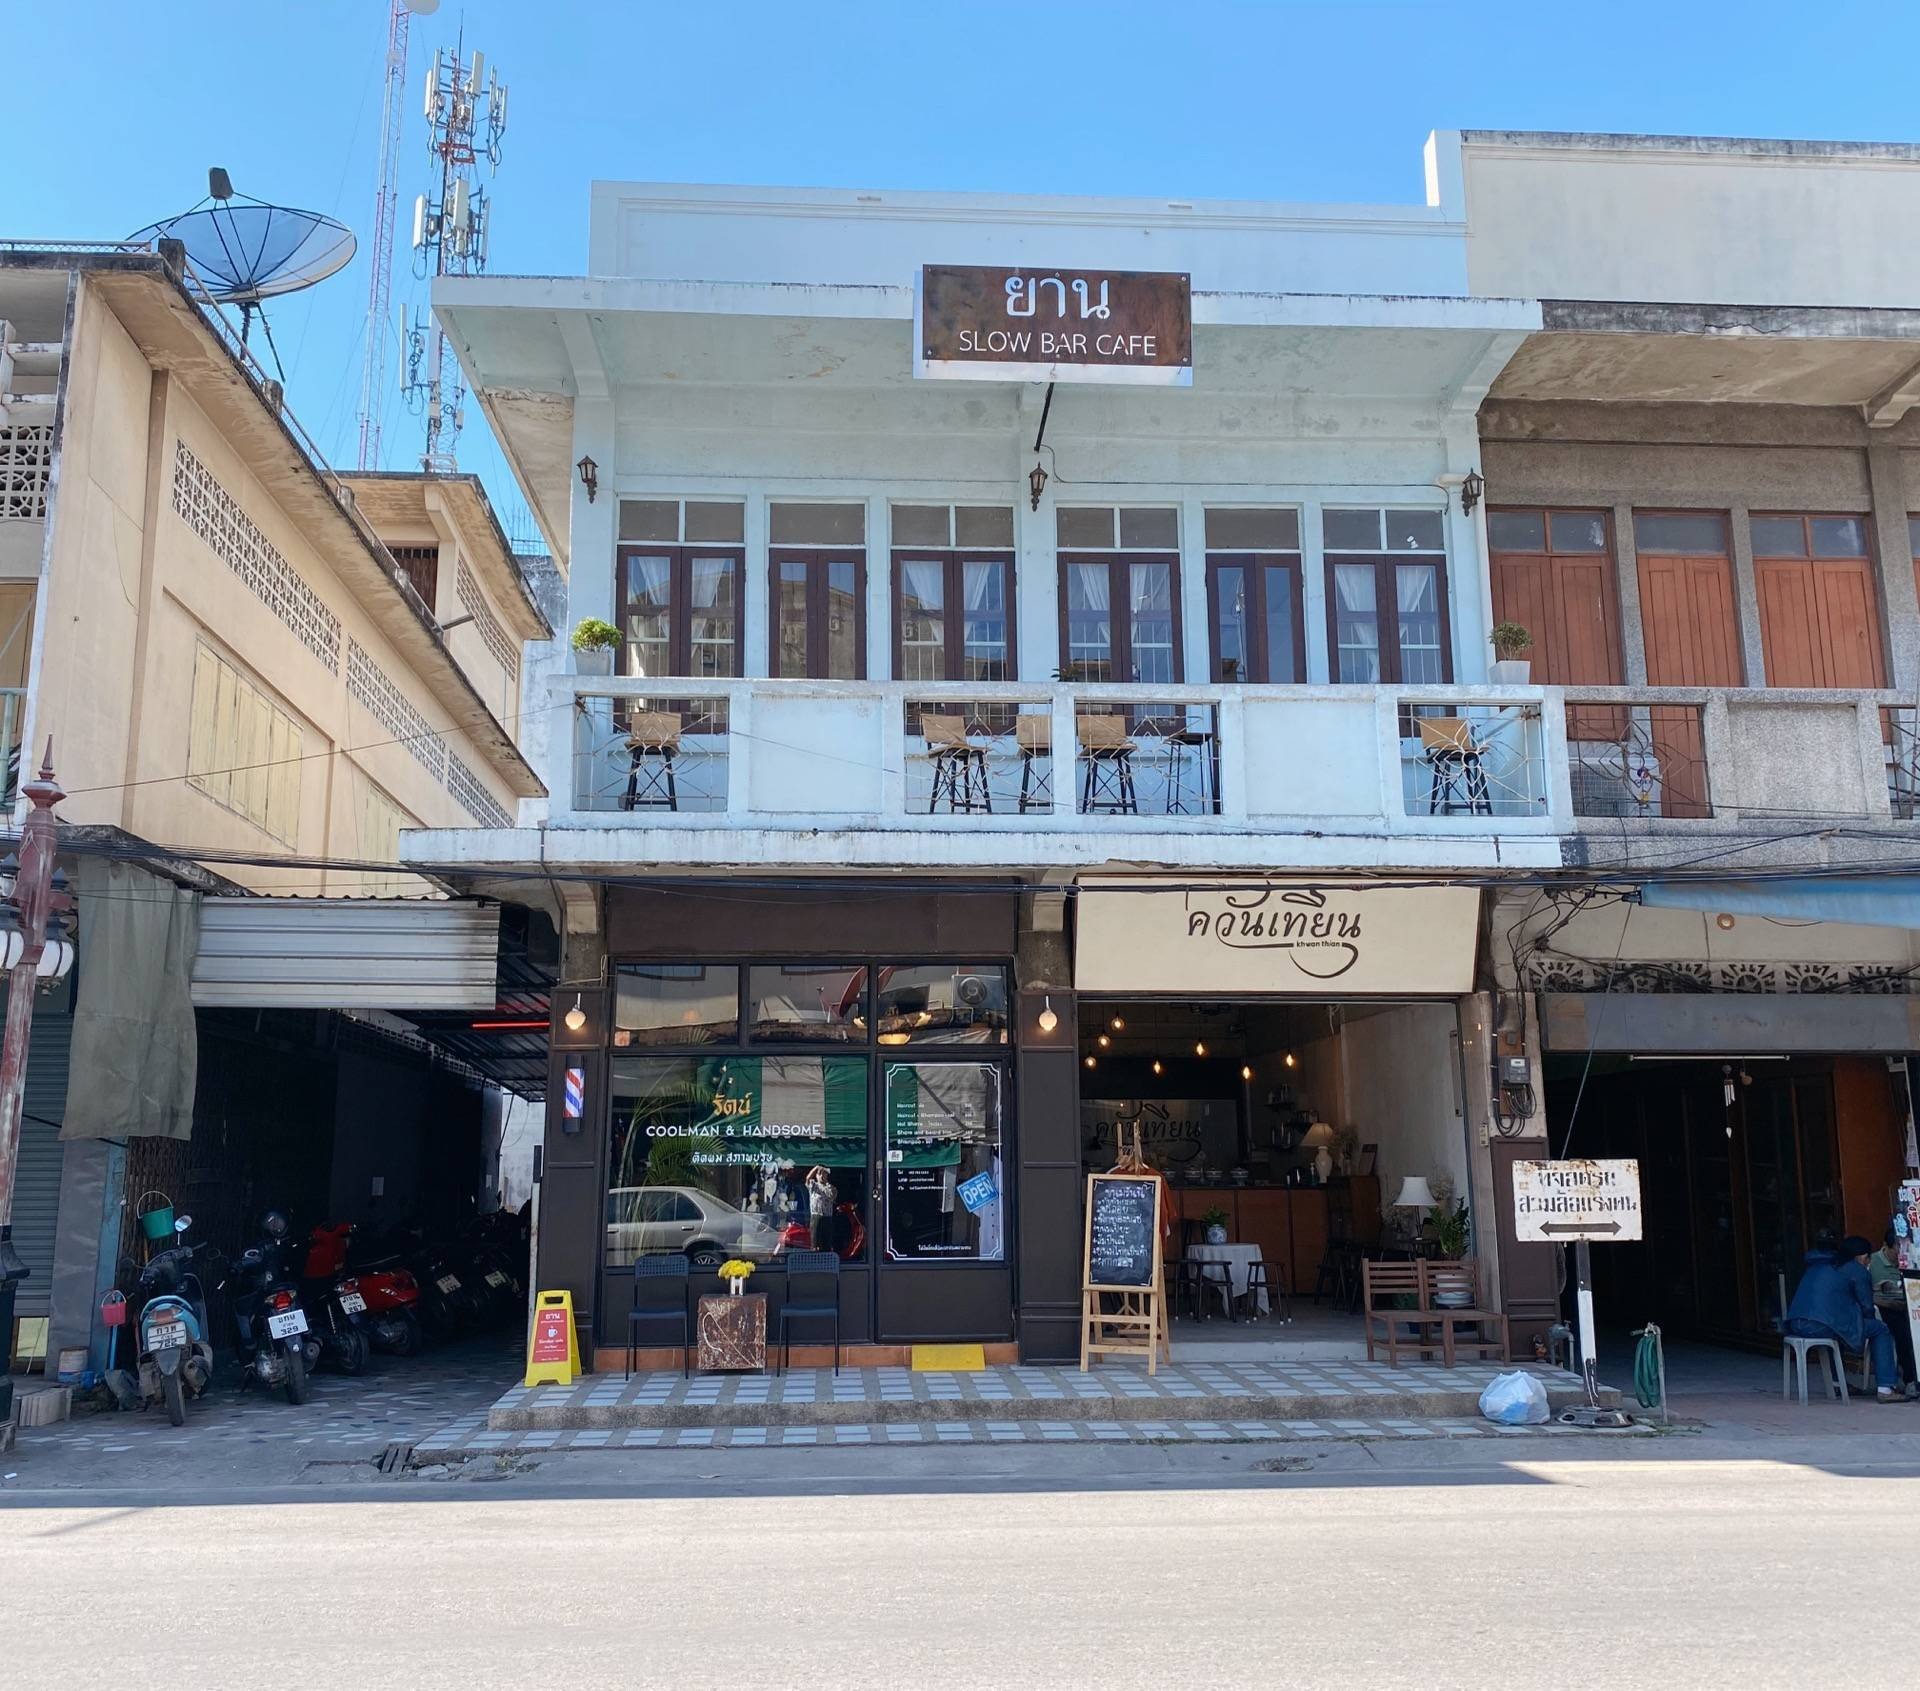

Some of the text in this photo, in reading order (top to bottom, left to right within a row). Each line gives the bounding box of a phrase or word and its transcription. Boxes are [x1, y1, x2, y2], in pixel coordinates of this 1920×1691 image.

[1004, 275, 1111, 320] ยาน
[959, 330, 1157, 356] SLOW BAR CAFE
[1296, 940, 1341, 948] khwan thian
[712, 1092, 753, 1117] รัตน์
[646, 1124, 821, 1137] COOLMAN & HANDSOME
[692, 1152, 723, 1164] ตัดผม
[963, 1178, 995, 1205] OPEN
[280, 1325, 299, 1336] 329
